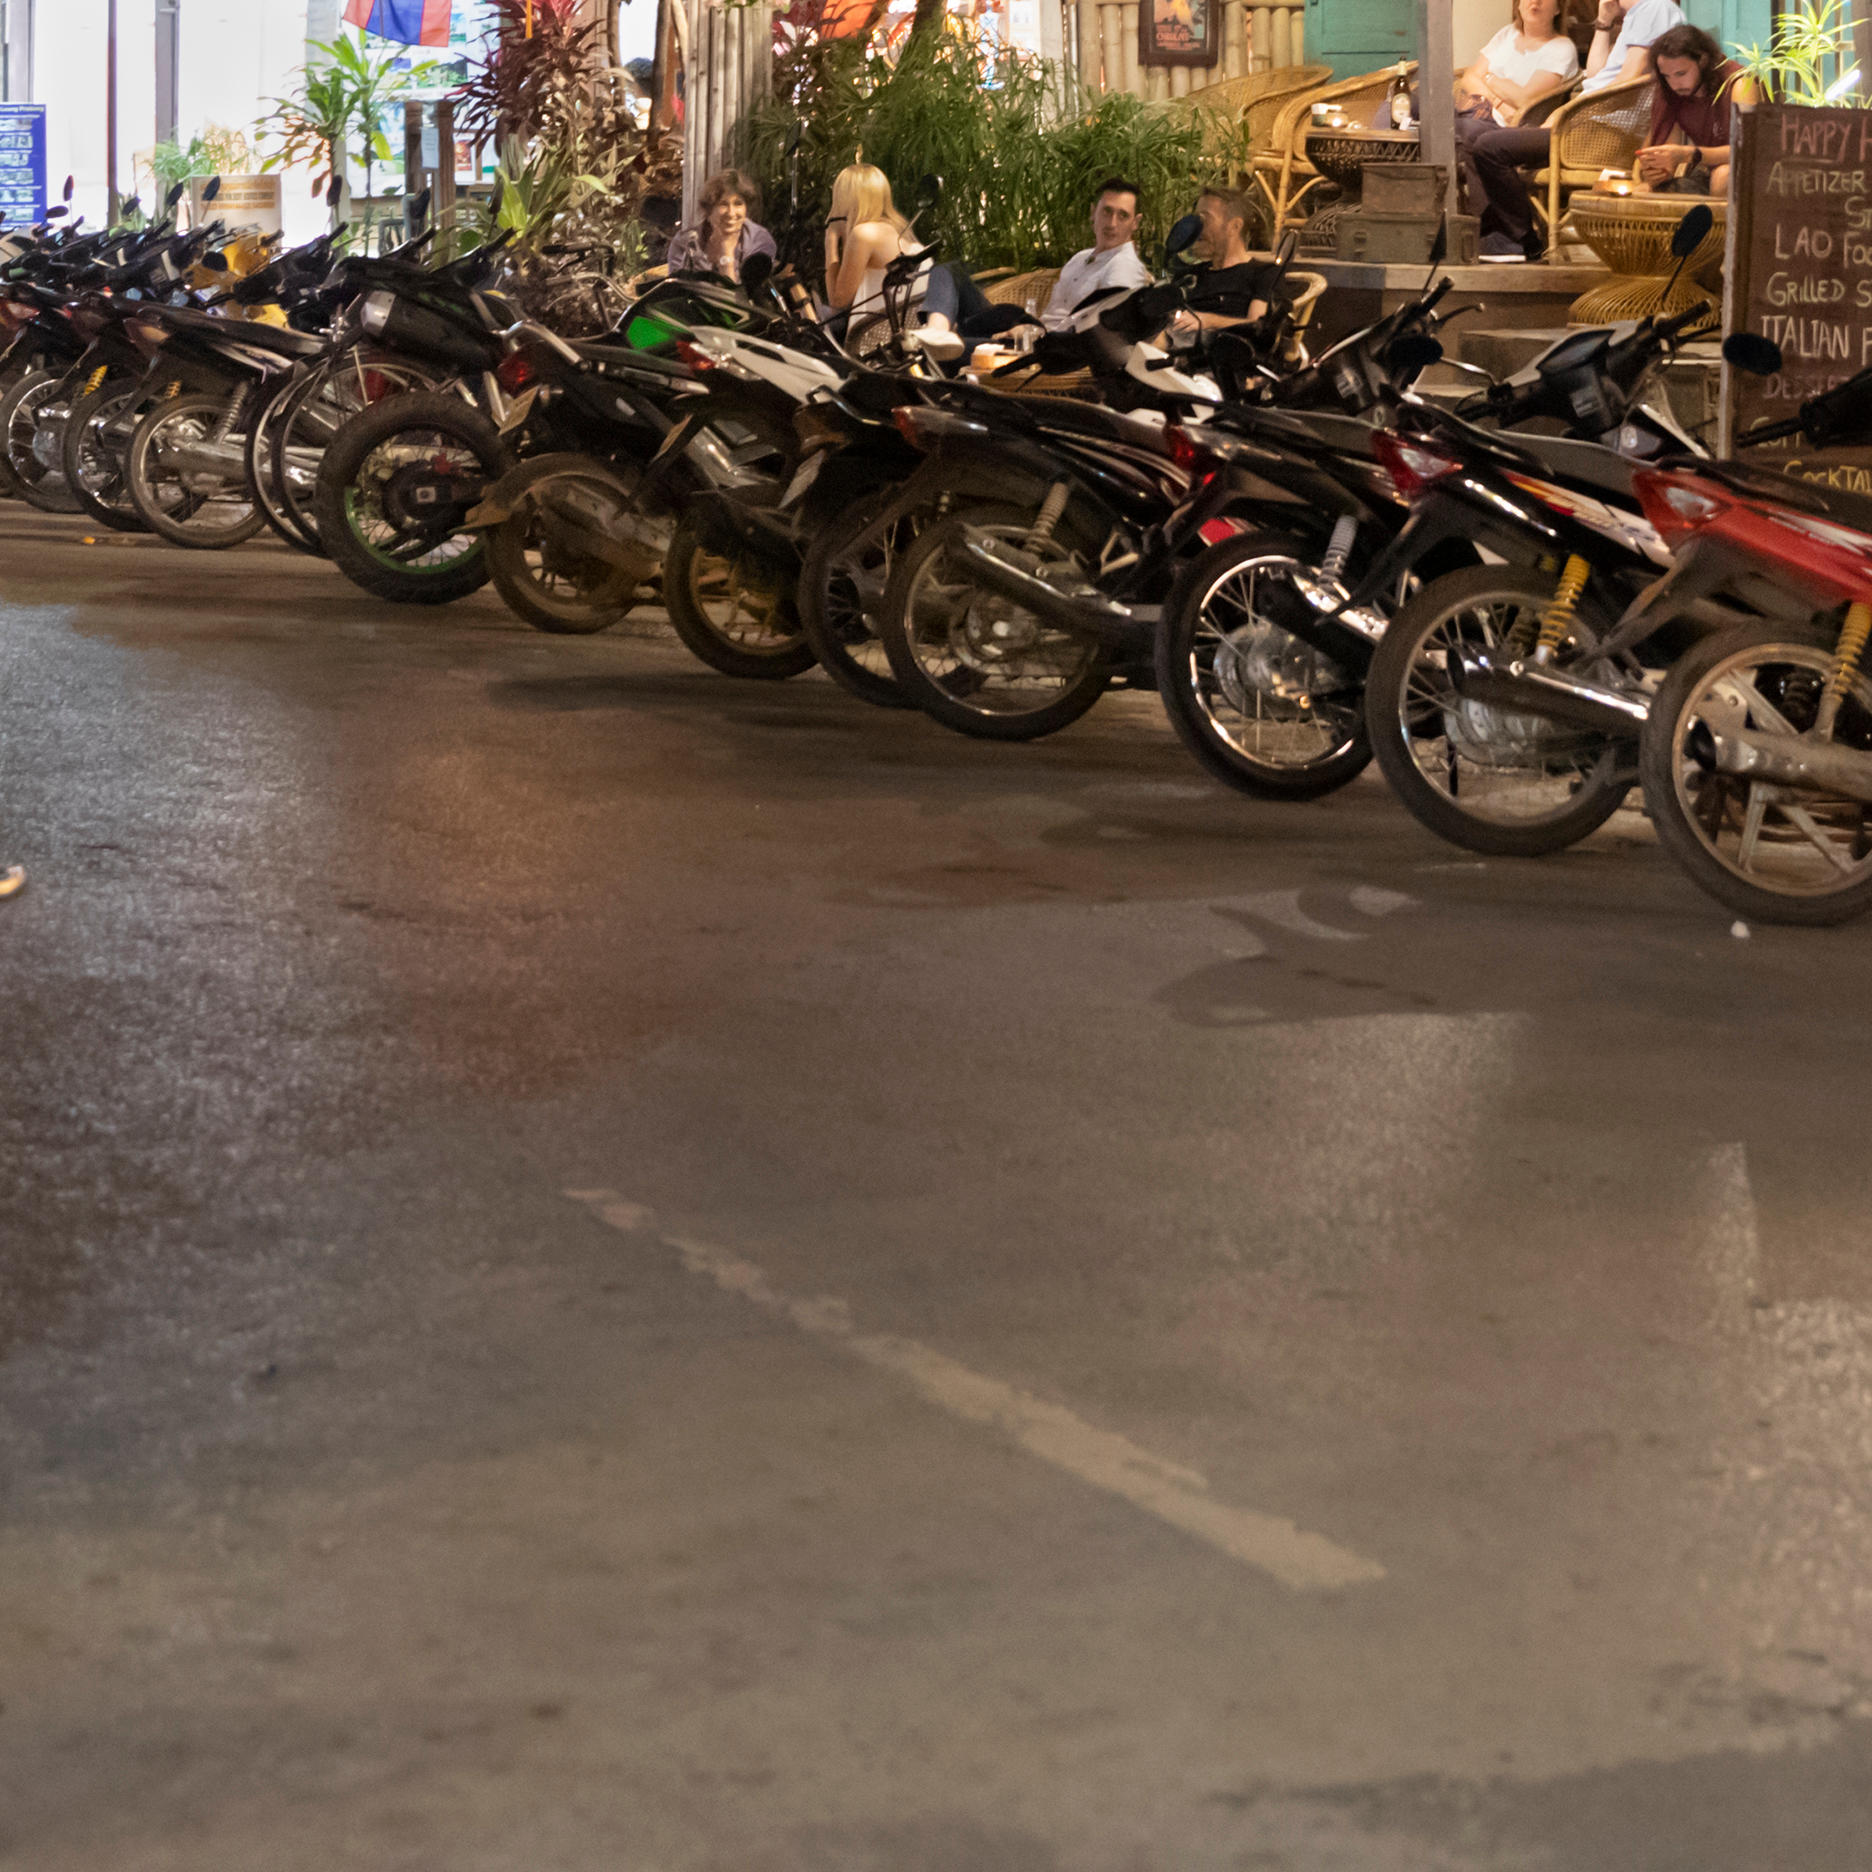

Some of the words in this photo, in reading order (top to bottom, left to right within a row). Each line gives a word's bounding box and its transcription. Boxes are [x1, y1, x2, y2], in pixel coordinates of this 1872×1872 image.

[1780, 113, 1853, 164] HAPPY
[1766, 161, 1870, 197] APPETIZER
[1775, 223, 1832, 260] LAO
[1761, 315, 1850, 360] ITALIAN
